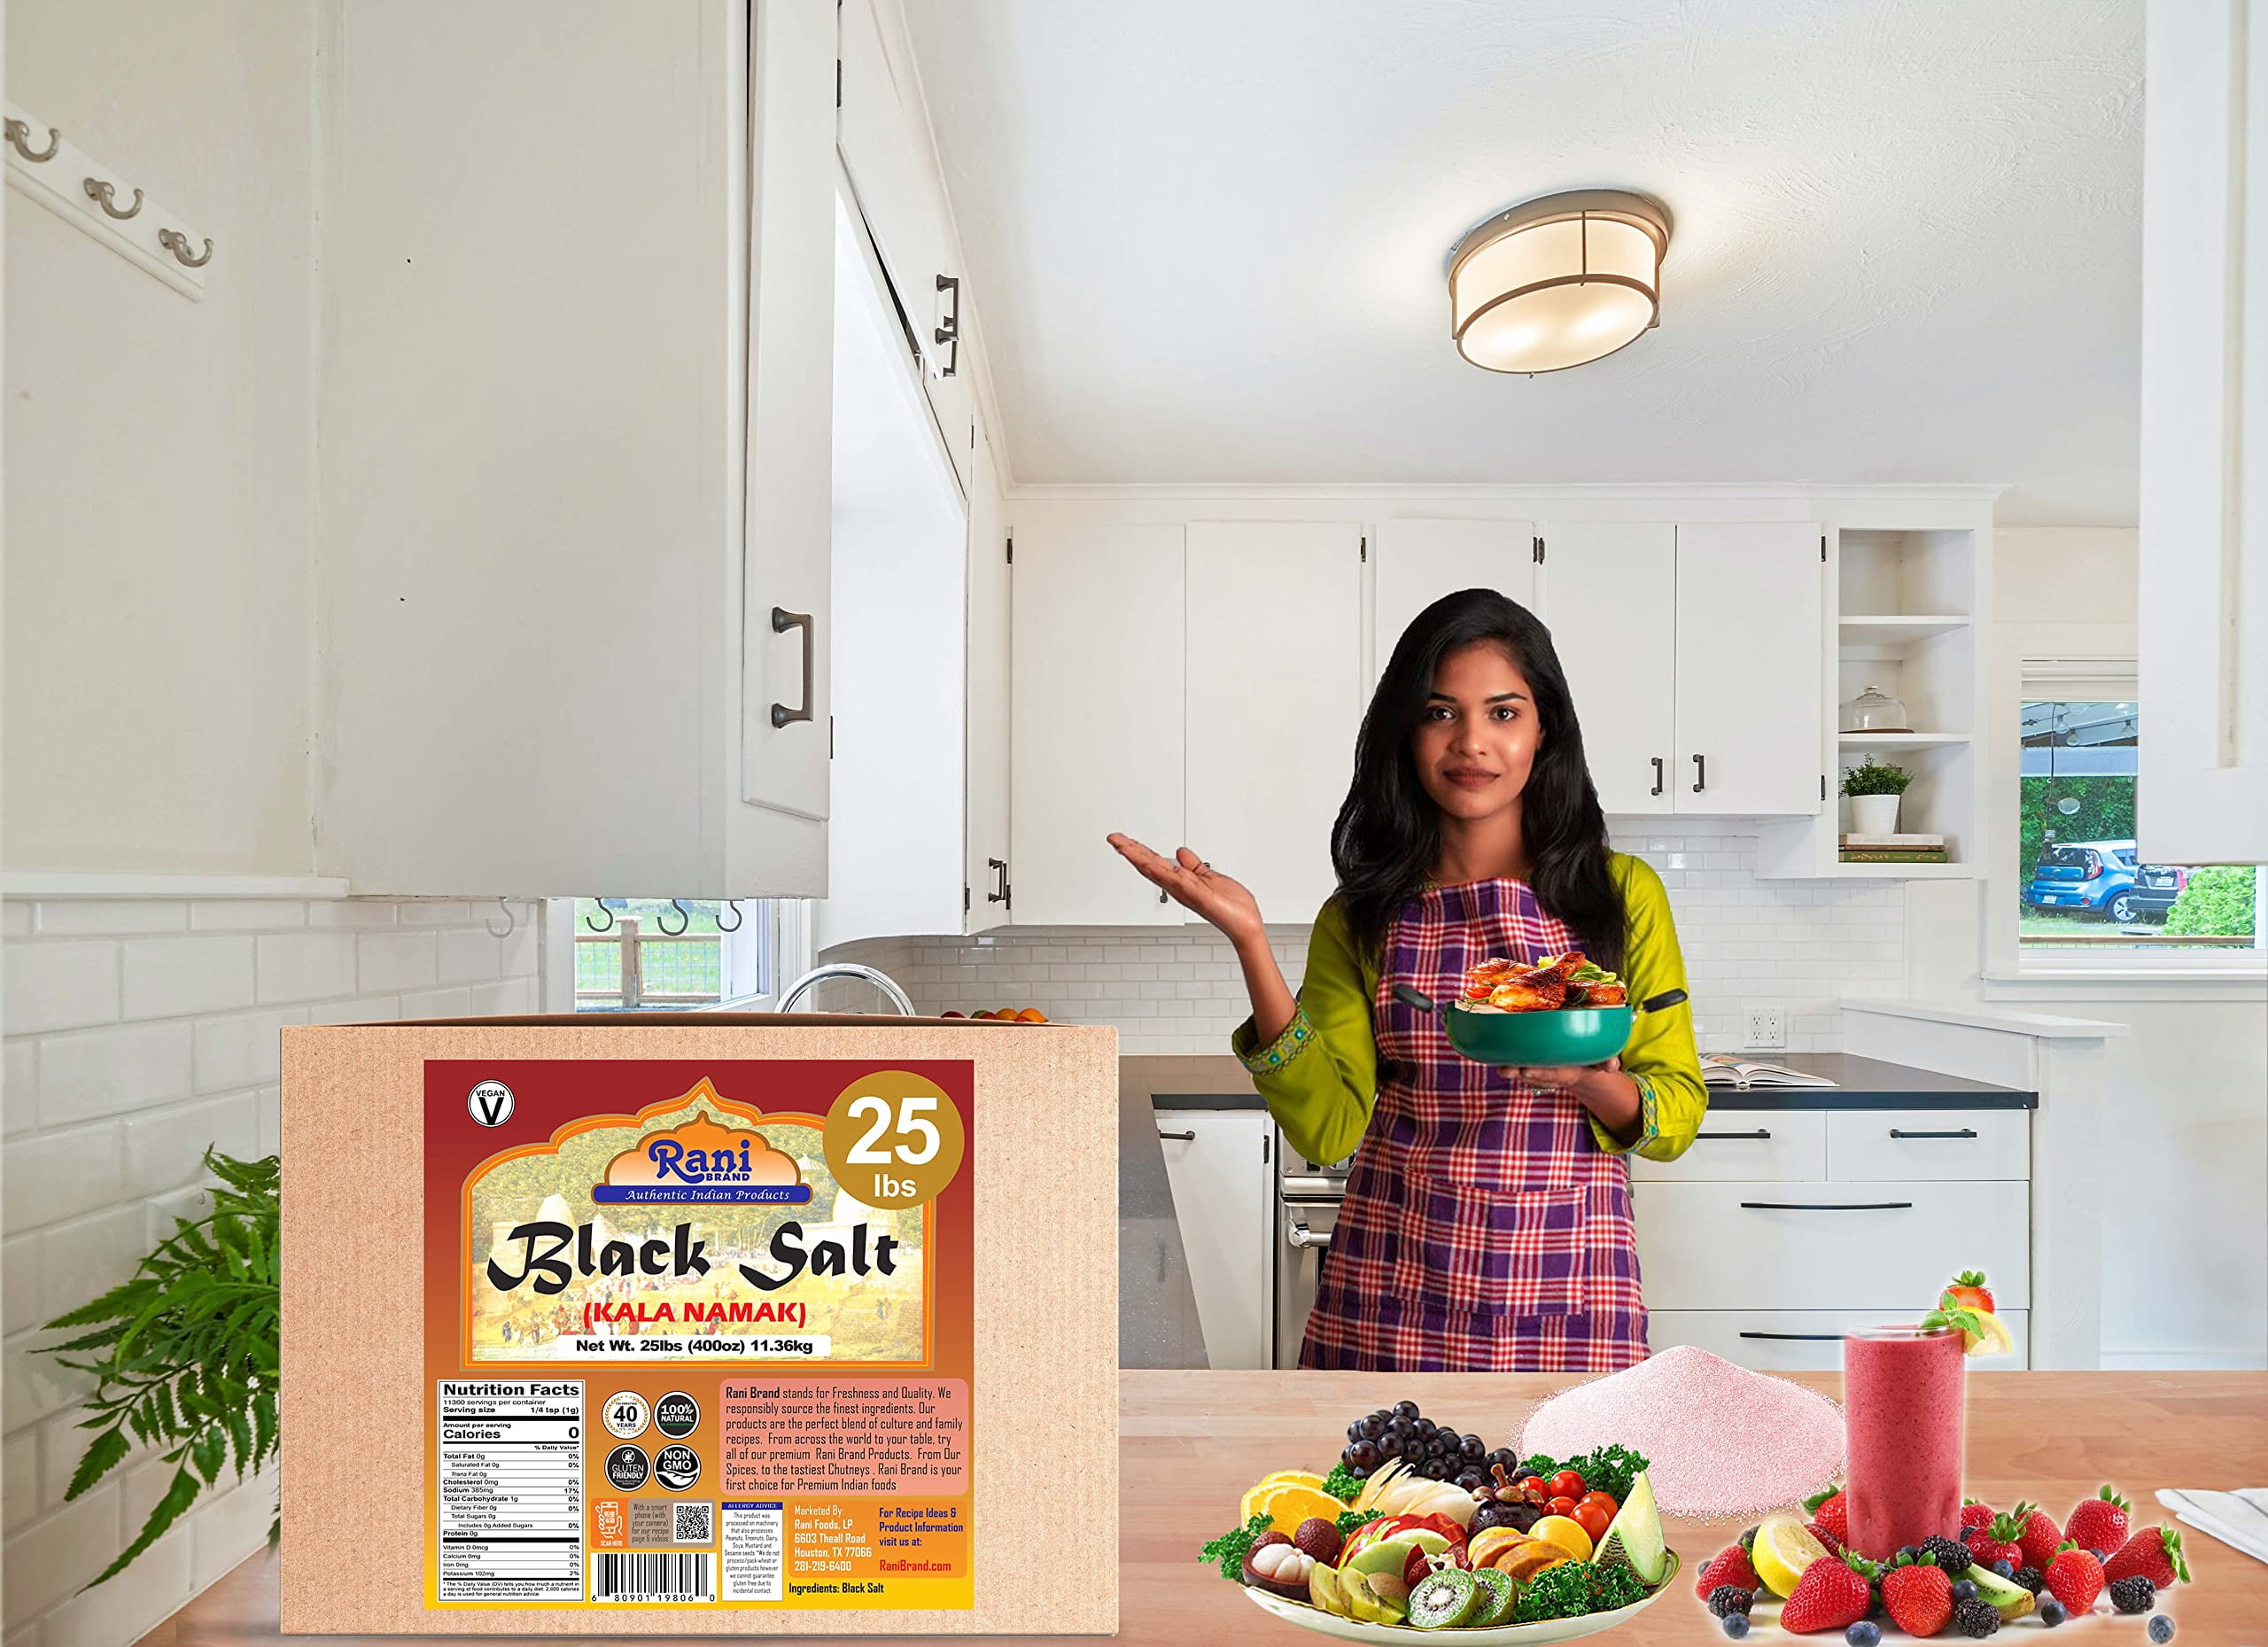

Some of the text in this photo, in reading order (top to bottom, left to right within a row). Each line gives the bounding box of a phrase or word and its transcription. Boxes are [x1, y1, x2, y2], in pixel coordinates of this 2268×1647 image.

[846, 1096, 941, 1165] 25
[649, 1139, 751, 1184] Rani
[705, 1173, 750, 1182] BRAND
[874, 1175, 917, 1197] lbs
[625, 1189, 789, 1200] Authentic Indian Products
[487, 1222, 898, 1294] Black Salt
[584, 1303, 805, 1327] (KALA NAMAK)
[577, 1340, 812, 1354] Net Wt. 25lbs (400oz) 11.36kg
[444, 1384, 579, 1395] Nutrition Facts
[726, 1387, 951, 1400] Rani Brand stands for Freshness and Quality. We
[614, 1406, 637, 1422] 40
[661, 1404, 694, 1415] 100%
[726, 1402, 778, 1416] responsibly
[816, 1402, 830, 1414] the
[833, 1402, 859, 1414] finest
[862, 1402, 915, 1416] ingredients.
[919, 1402, 935, 1413] Our
[726, 1418, 767, 1431] products
[788, 1417, 802, 1429] the
[806, 1417, 838, 1431] perfect
[842, 1417, 866, 1429] blend
[869, 1417, 878, 1429] of
[881, 1417, 913, 1429] culture
[917, 1418, 932, 1429] and
[935, 1417, 962, 1431] family
[444, 1427, 579, 1439] Calories 0
[726, 1434, 762, 1446] recipes.
[769, 1432, 791, 1444] From
[829, 1433, 843, 1444] the
[846, 1432, 871, 1444] world
[875, 1434, 883, 1444] to
[887, 1437, 907, 1446] your
[938, 1435, 951, 1446] try
[664, 1450, 690, 1460] NON
[726, 1448, 736, 1459] all
[740, 1447, 748, 1459] of
[770, 1449, 810, 1462] premium
[816, 1448, 835, 1459] Rani
[839, 1447, 865, 1459] Brand
[869, 1448, 911, 1459] Products.
[918, 1448, 941, 1459] From
[944, 1448, 961, 1459] Our
[663, 1460, 691, 1470] GMO
[726, 1463, 962, 1477] Spices, to the tastiest Chutneys Rani Brand is your
[726, 1478, 896, 1490] first choice for Premium Indian foods
[795, 1505, 843, 1517] Marketed By:
[879, 1507, 956, 1519] For Recipe Ideas &
[795, 1519, 853, 1530] Rani Foods, LP
[879, 1522, 963, 1532] Product Information
[795, 1533, 865, 1543] 6603 Theall Road
[879, 1537, 897, 1546] visit
[795, 1547, 872, 1558] Houston, TX 77066
[795, 1561, 851, 1571] 281-219-6400
[880, 1559, 951, 1571] RaniBrand.com
[789, 1583, 884, 1595] Ingredients: Black Salt
